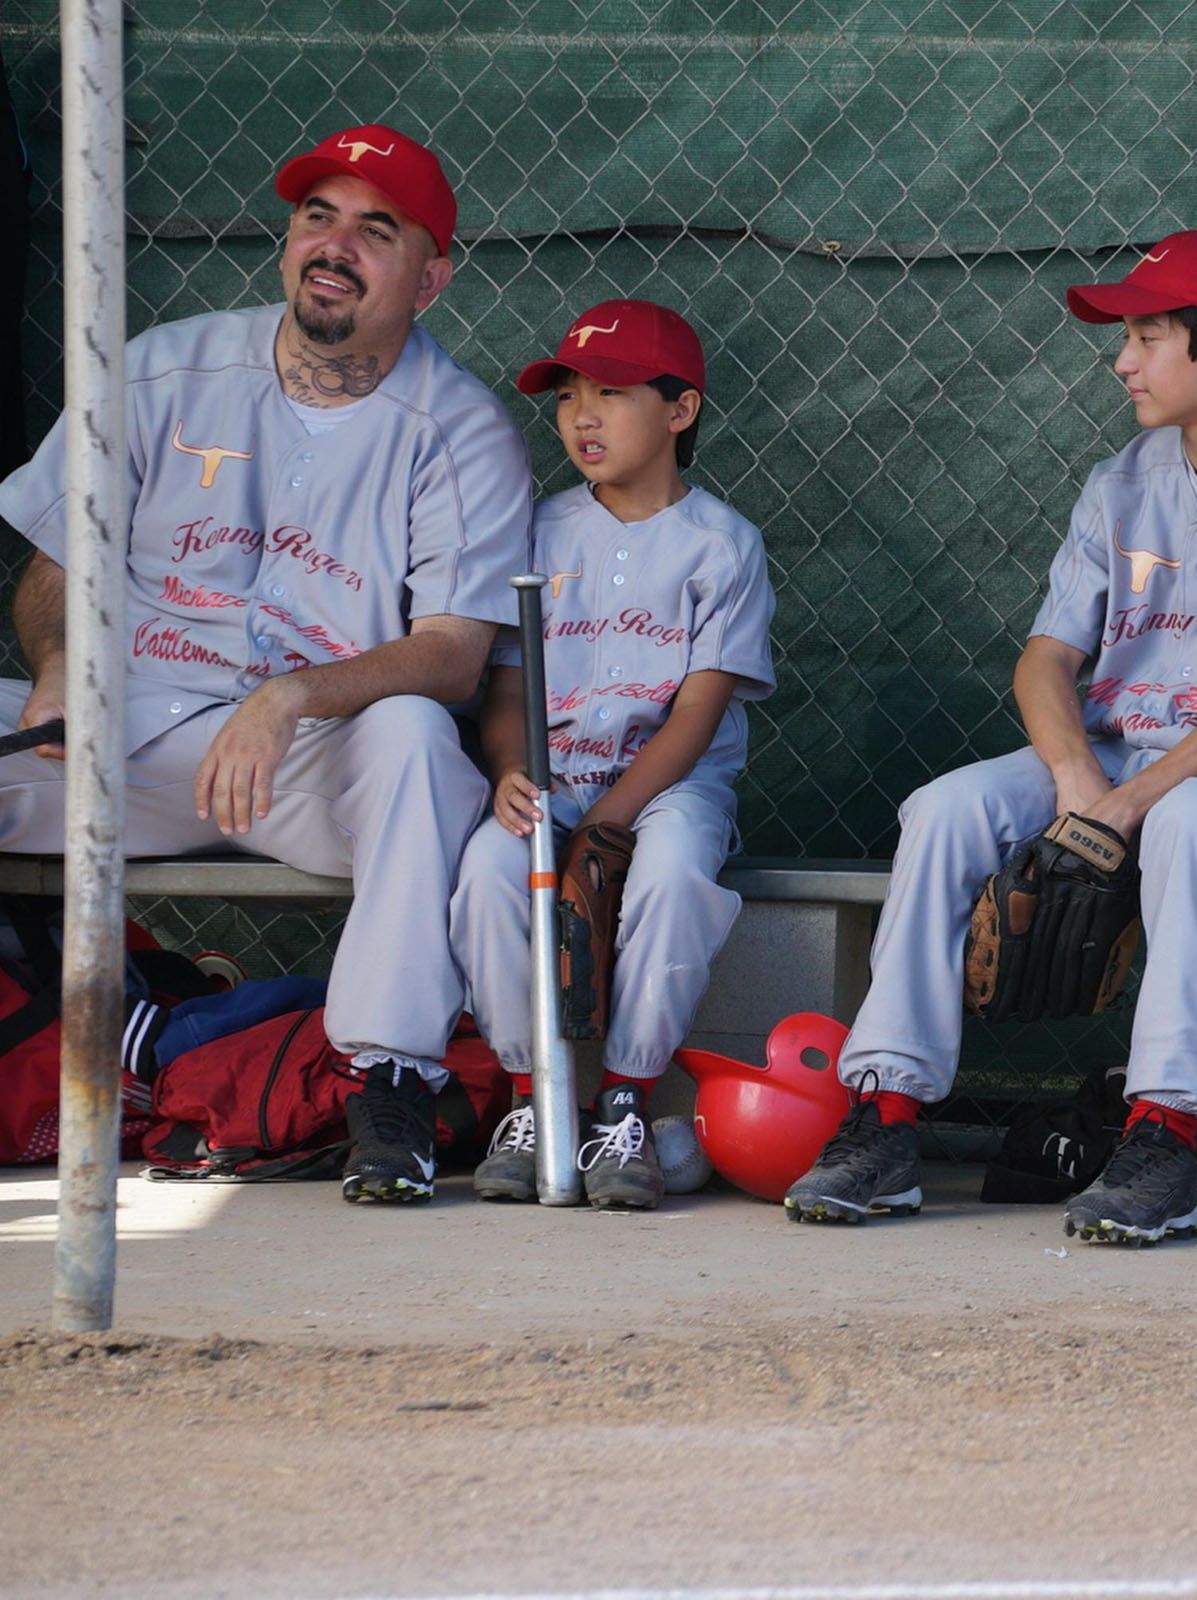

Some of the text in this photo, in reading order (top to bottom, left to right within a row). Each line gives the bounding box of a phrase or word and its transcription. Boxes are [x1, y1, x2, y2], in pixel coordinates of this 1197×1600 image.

[171, 516, 363, 592] Kenny Rogers
[541, 612, 609, 643] enny
